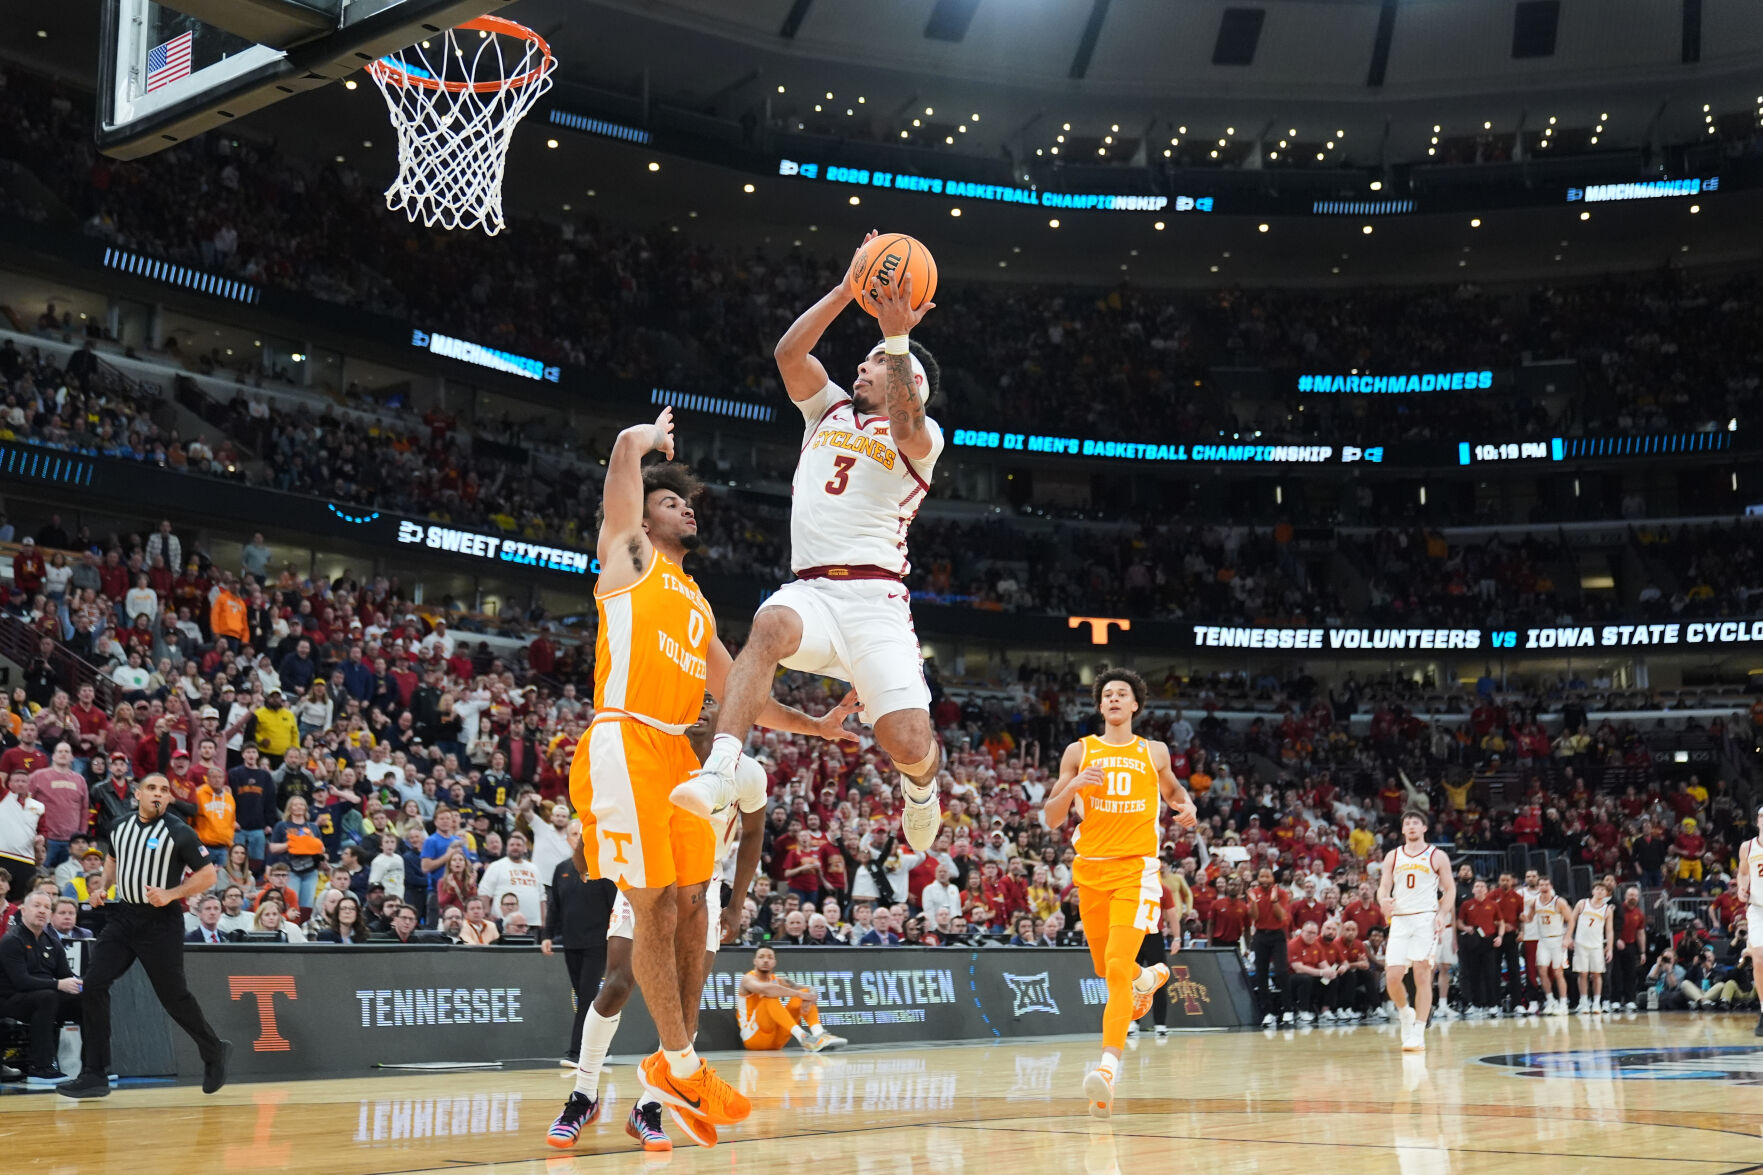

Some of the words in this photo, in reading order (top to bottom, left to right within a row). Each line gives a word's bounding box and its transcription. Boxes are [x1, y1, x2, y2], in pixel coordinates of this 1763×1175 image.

[826, 166, 870, 184] 2026
[872, 171, 892, 187] DI
[895, 174, 943, 193] MEN'S
[946, 180, 1038, 204] BASKETBALL
[1041, 192, 1167, 210] CHAMPIONSHIP
[1585, 178, 1701, 202] MARCHMADNESS
[430, 332, 545, 381] MARCHMADNESS
[1298, 371, 1493, 393] #MARCHMADNESS
[812, 430, 896, 471] CYCLONES
[953, 429, 1000, 447] 2026
[1003, 433, 1025, 449] DI
[1028, 435, 1080, 454] MEN'S
[1083, 440, 1188, 461] BASKETBALL
[1192, 445, 1332, 462] CHAMPIONSHIP
[1475, 444, 1519, 460] 10:19
[1521, 442, 1547, 458] PM
[824, 455, 857, 495] 3
[426, 526, 500, 558] SWEET
[500, 540, 588, 574] SIXTEEN
[688, 608, 704, 649] 0
[1068, 616, 1130, 645] T
[1194, 626, 1324, 648] TENNESSEE
[1329, 629, 1481, 649] VOLUNTEERS
[1492, 631, 1517, 647] VS
[1526, 627, 1595, 648] IOWA
[1602, 624, 1680, 645] STATE
[1107, 771, 1131, 796] 10
[1090, 796, 1146, 813] VOLUNTEERS
[1407, 874, 1415, 888] 0
[860, 969, 956, 1006] SIXTEEN
[228, 975, 298, 1052] T
[355, 988, 524, 1027] TENNESSEE
